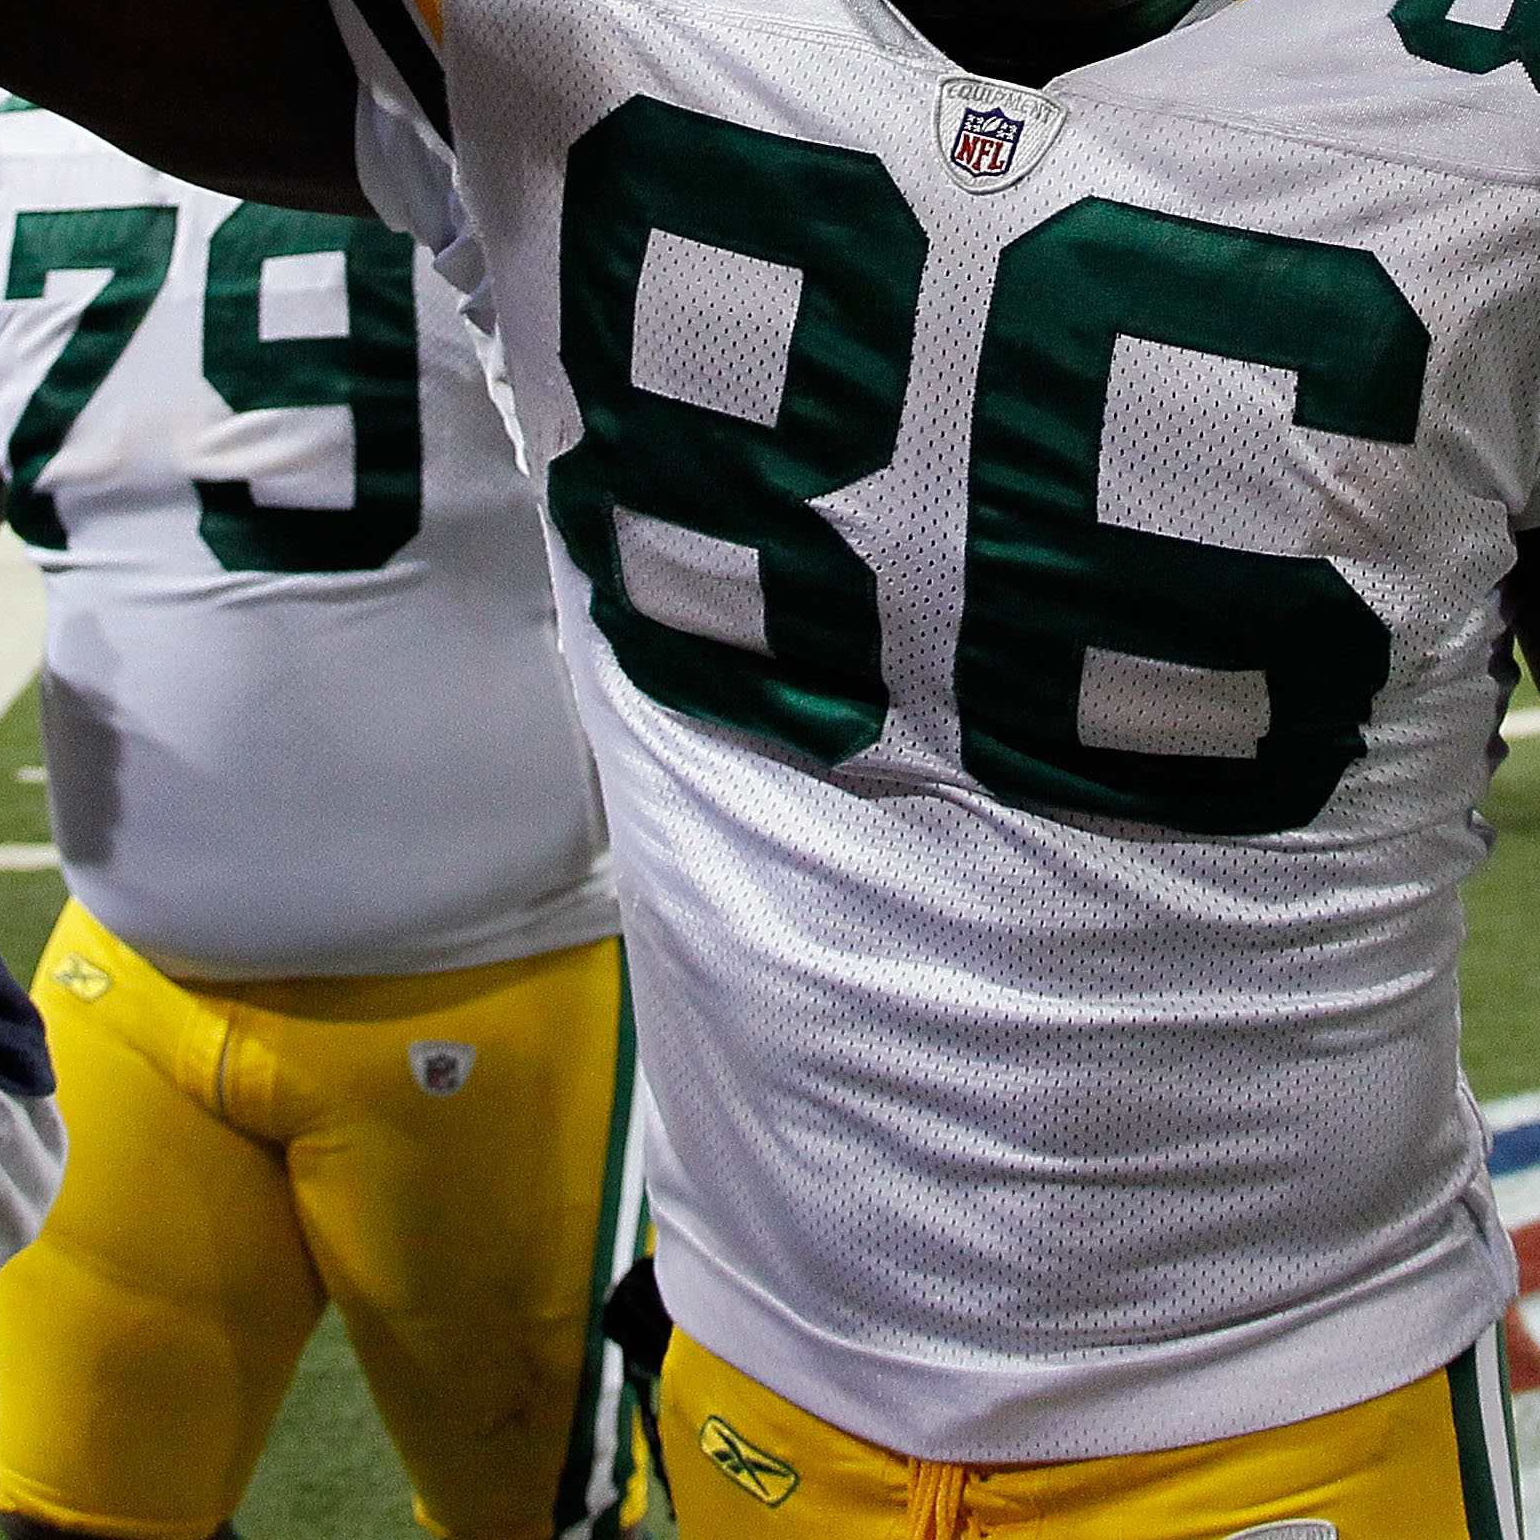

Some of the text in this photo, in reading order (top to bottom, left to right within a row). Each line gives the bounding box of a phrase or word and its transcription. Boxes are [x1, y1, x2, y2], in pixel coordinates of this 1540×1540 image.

[946, 81, 1054, 125] EQUIPMENT
[954, 132, 1006, 171] NFL
[2, 198, 424, 573] 79
[546, 94, 1432, 836] 86
